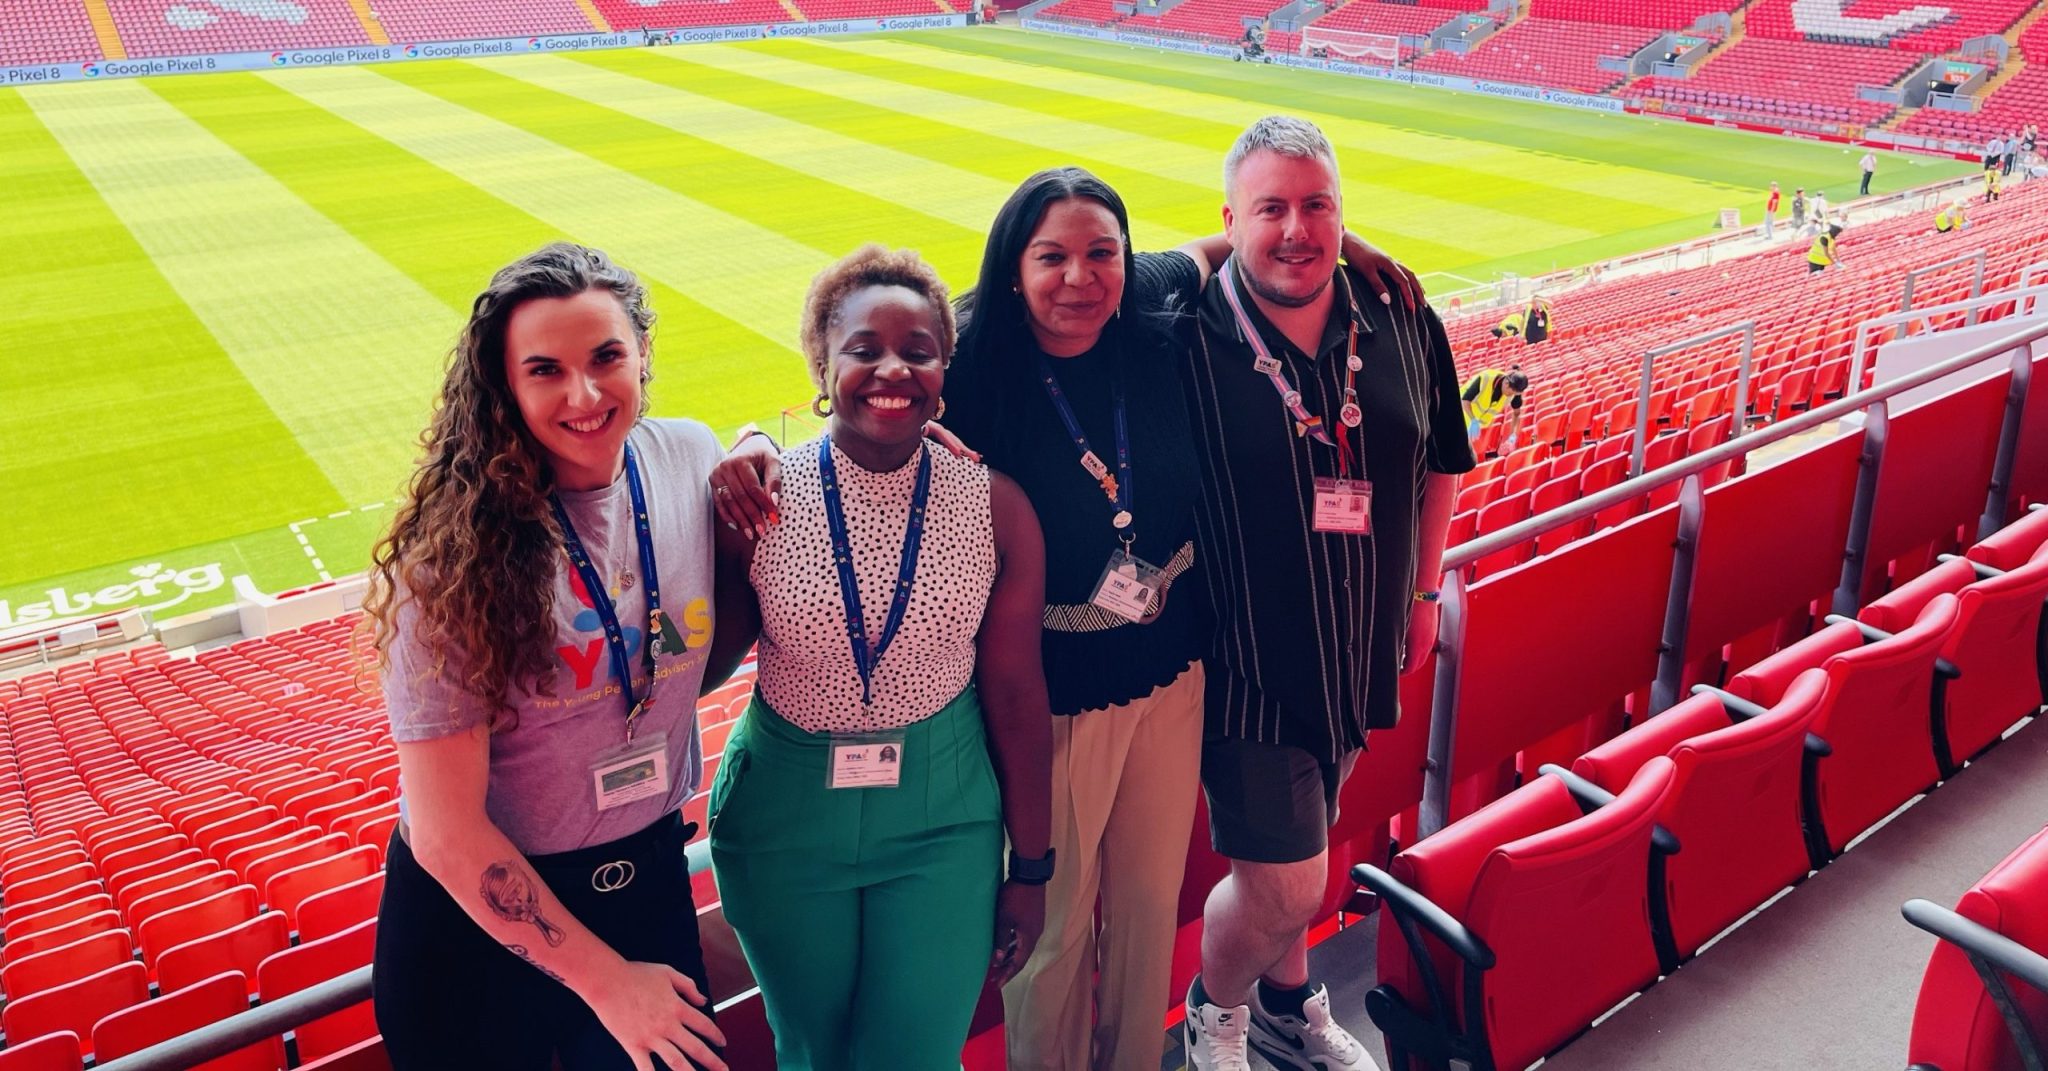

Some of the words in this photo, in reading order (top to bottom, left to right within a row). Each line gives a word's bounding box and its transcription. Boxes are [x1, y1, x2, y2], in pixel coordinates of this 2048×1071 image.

[780, 25, 816, 36] Google
[818, 23, 841, 33] Pixel
[842, 23, 848, 32] 8
[889, 19, 922, 29] Google
[924, 18, 944, 26] Pixel
[946, 18, 952, 26] 8
[545, 37, 588, 49] Google
[591, 35, 618, 45] Pixel
[620, 35, 627, 45] 8
[683, 31, 722, 42] Google
[725, 29, 748, 39] Pixel
[751, 28, 757, 37] 8
[292, 51, 344, 64] Google
[347, 48, 380, 61] Pixel
[382, 48, 391, 59] 8
[423, 44, 471, 57] Google
[473, 42, 502, 53] Pixel
[505, 41, 512, 51] 8
[105, 61, 163, 76] Google
[167, 57, 203, 71] Pixel
[206, 57, 216, 69] 8
[9, 68, 47, 82] Pixel
[51, 67, 61, 79] 8
[1482, 83, 1512, 96] Google
[1513, 86, 1533, 98] Pixel
[1534, 89, 1540, 99] 8
[1553, 92, 1586, 106] Google
[1587, 96, 1609, 109] Pixel
[1610, 99, 1616, 110] 8
[535, 700, 560, 709] The
